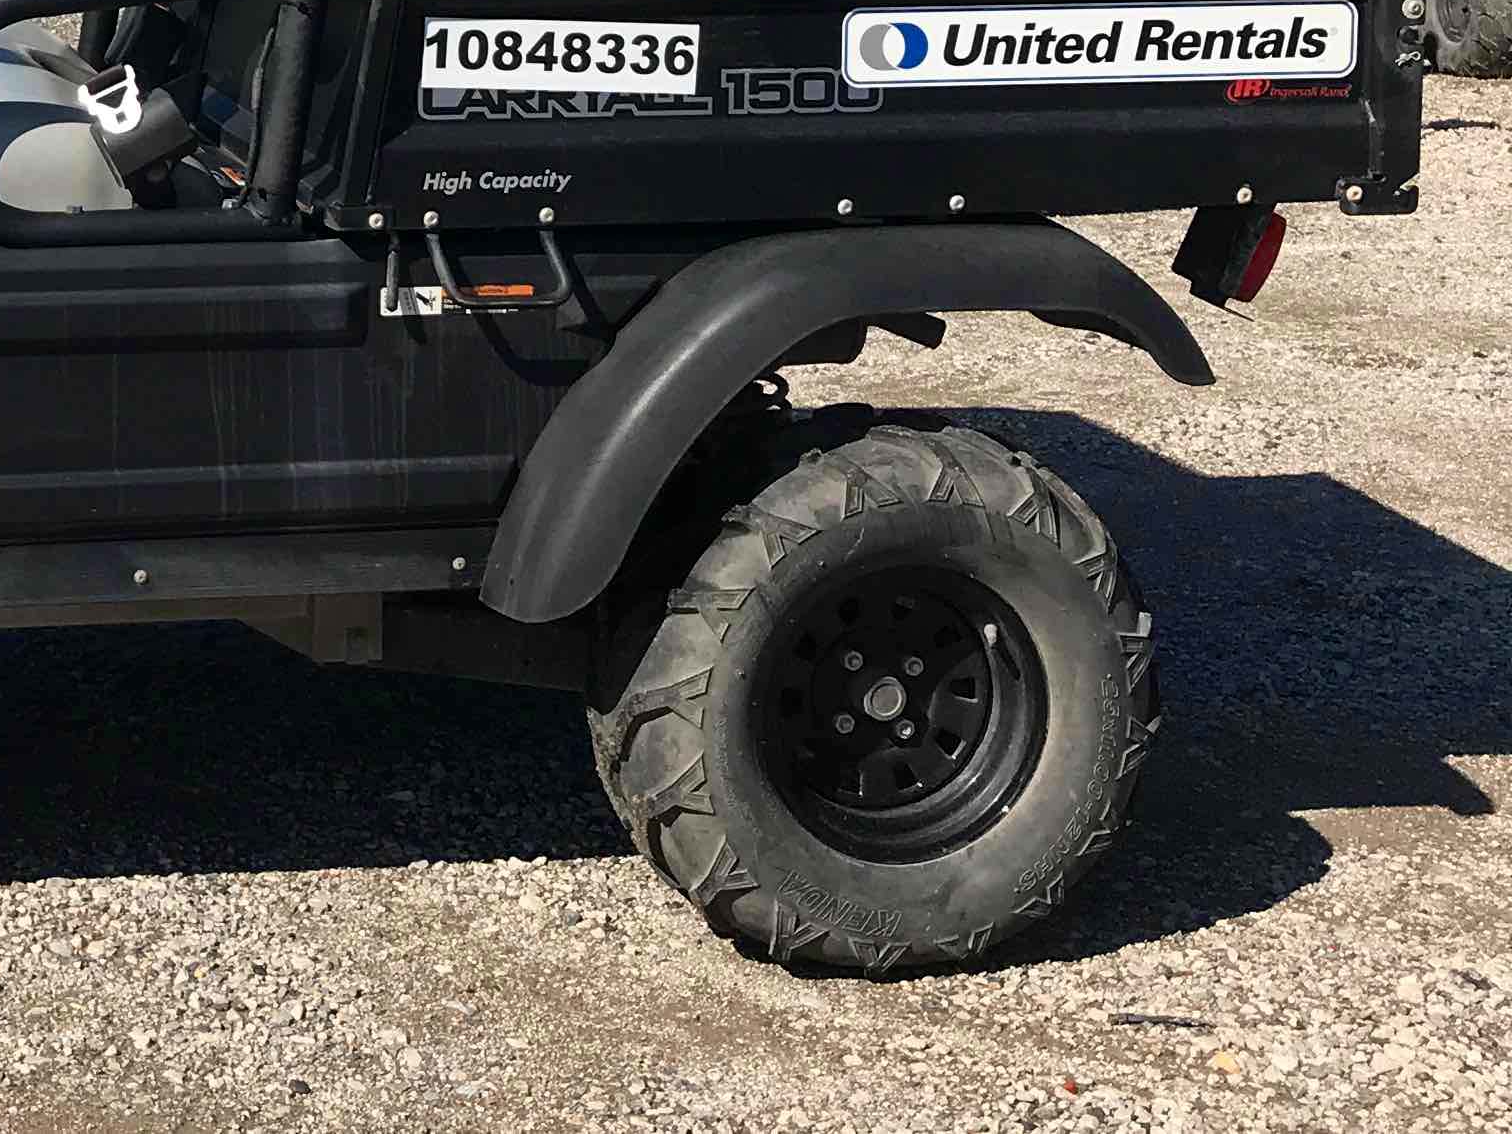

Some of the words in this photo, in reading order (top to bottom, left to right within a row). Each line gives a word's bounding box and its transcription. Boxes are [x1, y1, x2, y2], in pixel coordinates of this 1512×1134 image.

[425, 27, 695, 76] 10848336
[943, 21, 1123, 67] United
[1134, 16, 1329, 62] Rentals
[422, 172, 472, 192] High
[478, 171, 572, 193] Capacity
